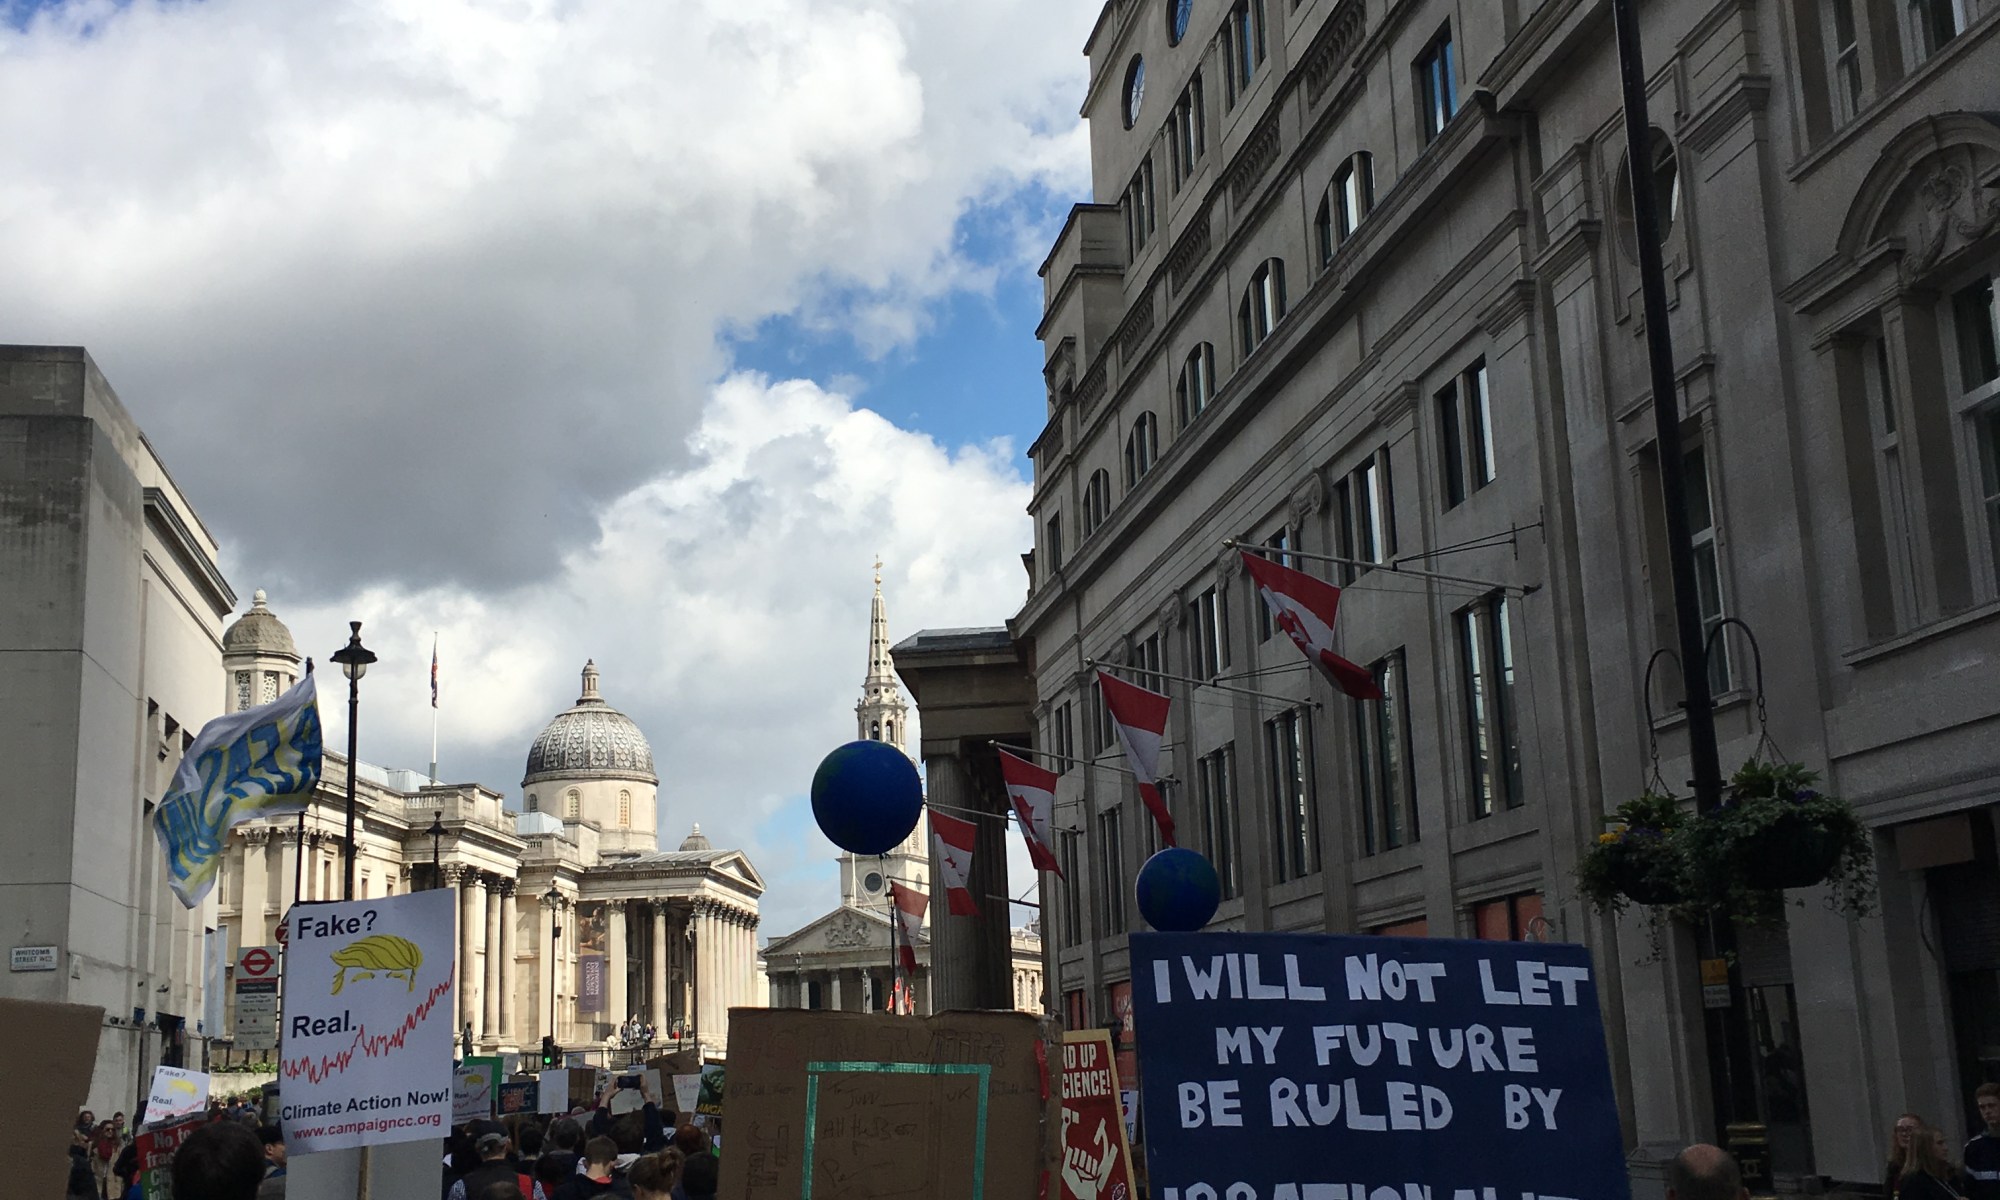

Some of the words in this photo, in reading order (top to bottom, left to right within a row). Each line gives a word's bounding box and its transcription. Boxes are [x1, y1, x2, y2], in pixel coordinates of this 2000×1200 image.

[298, 910, 377, 940] Fake?
[1153, 959, 1171, 1003] I
[1181, 953, 1326, 1001] WILL
[1345, 953, 1447, 1002] NOT
[1478, 959, 1589, 1006] LET
[292, 1010, 357, 1038] Real.
[1080, 1043, 1097, 1068] UP
[1216, 1026, 1284, 1064] MY
[1312, 1022, 1539, 1072] FUTURE
[158, 1068, 186, 1078] Fake?
[1062, 1069, 1110, 1099] CIENCE!
[282, 1100, 342, 1121] Climate
[346, 1095, 401, 1112] Action
[407, 1088, 449, 1106] Now!
[1178, 1080, 1243, 1128] BE
[1269, 1077, 1453, 1131] RULED
[1504, 1084, 1563, 1130] BY
[154, 1132, 174, 1149] No
[177, 1127, 191, 1144] to
[293, 1114, 441, 1139] www.campaigncc.org
